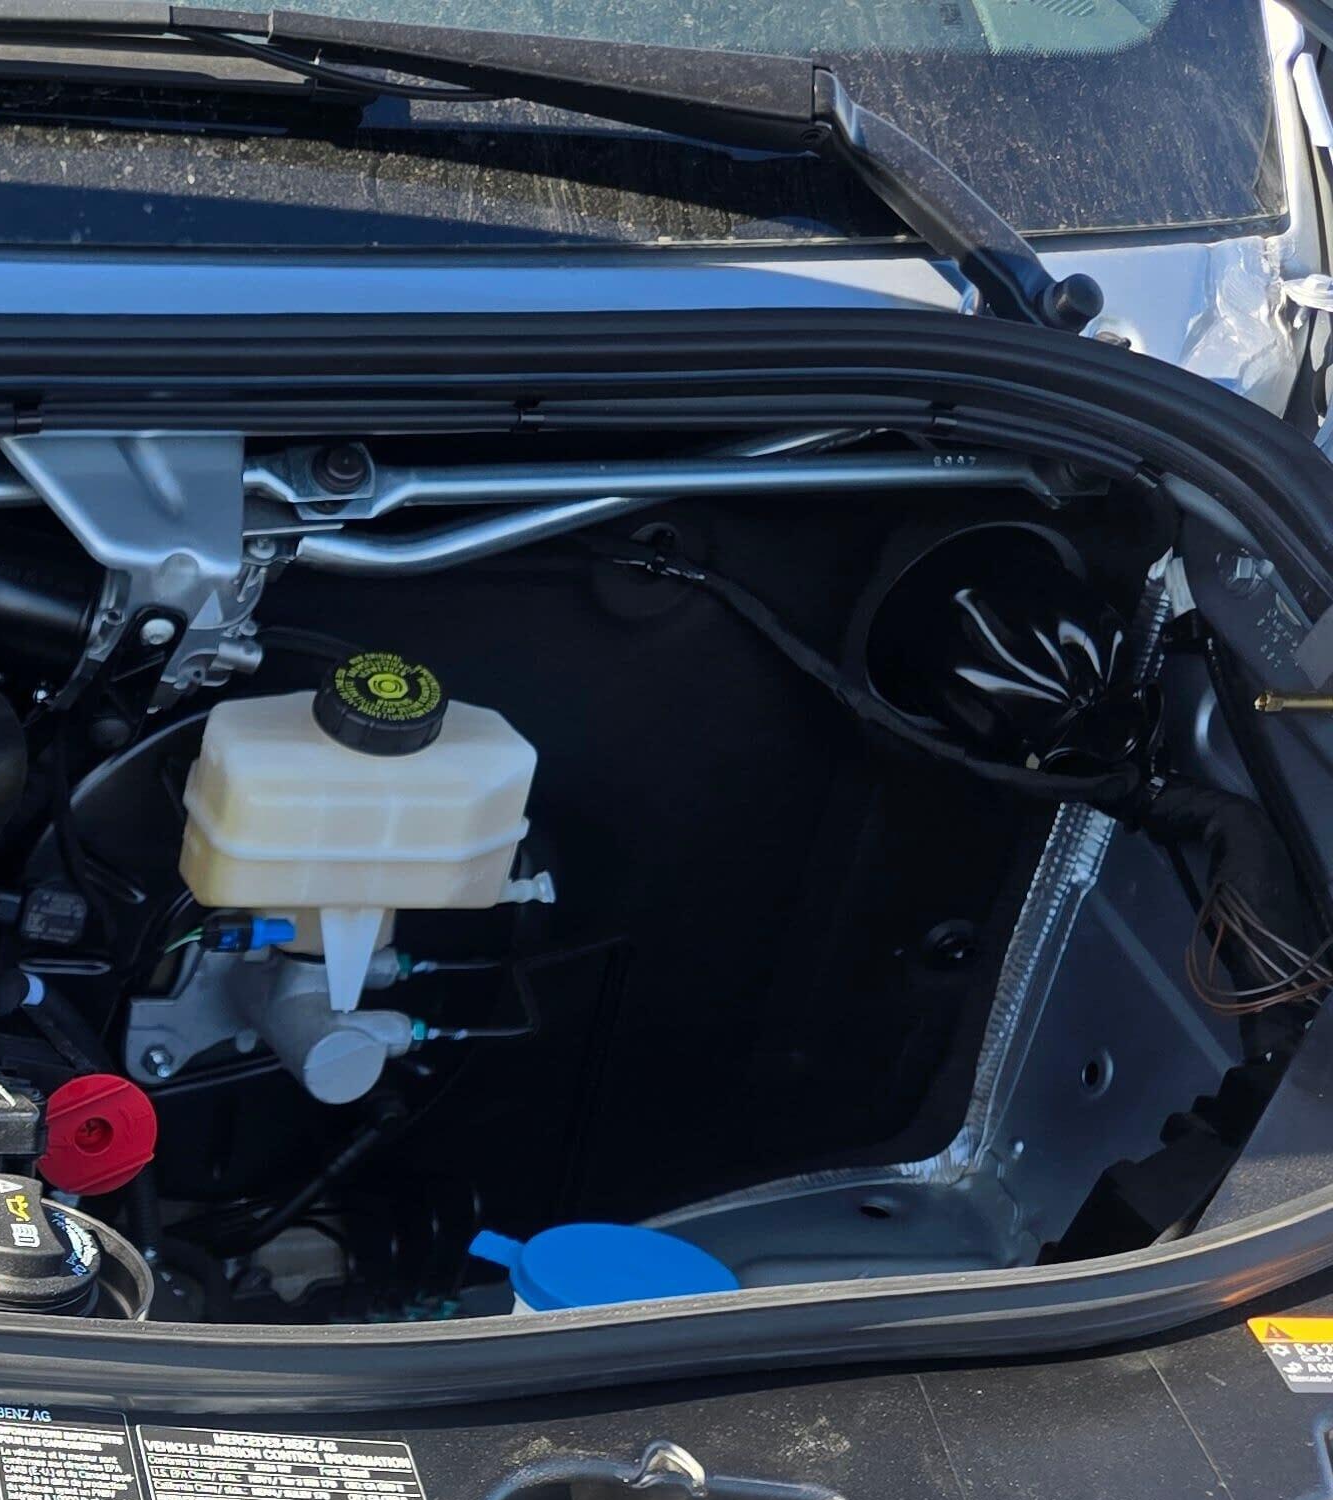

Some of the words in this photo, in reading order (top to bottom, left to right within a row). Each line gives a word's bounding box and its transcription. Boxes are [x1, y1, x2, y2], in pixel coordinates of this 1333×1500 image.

[33, 1410, 52, 1422] AG
[144, 1440, 199, 1454] VEHICLE
[199, 1444, 262, 1459] EMISSION
[262, 1448, 324, 1464] CONTROL
[324, 1453, 412, 1469] INFORMATION
